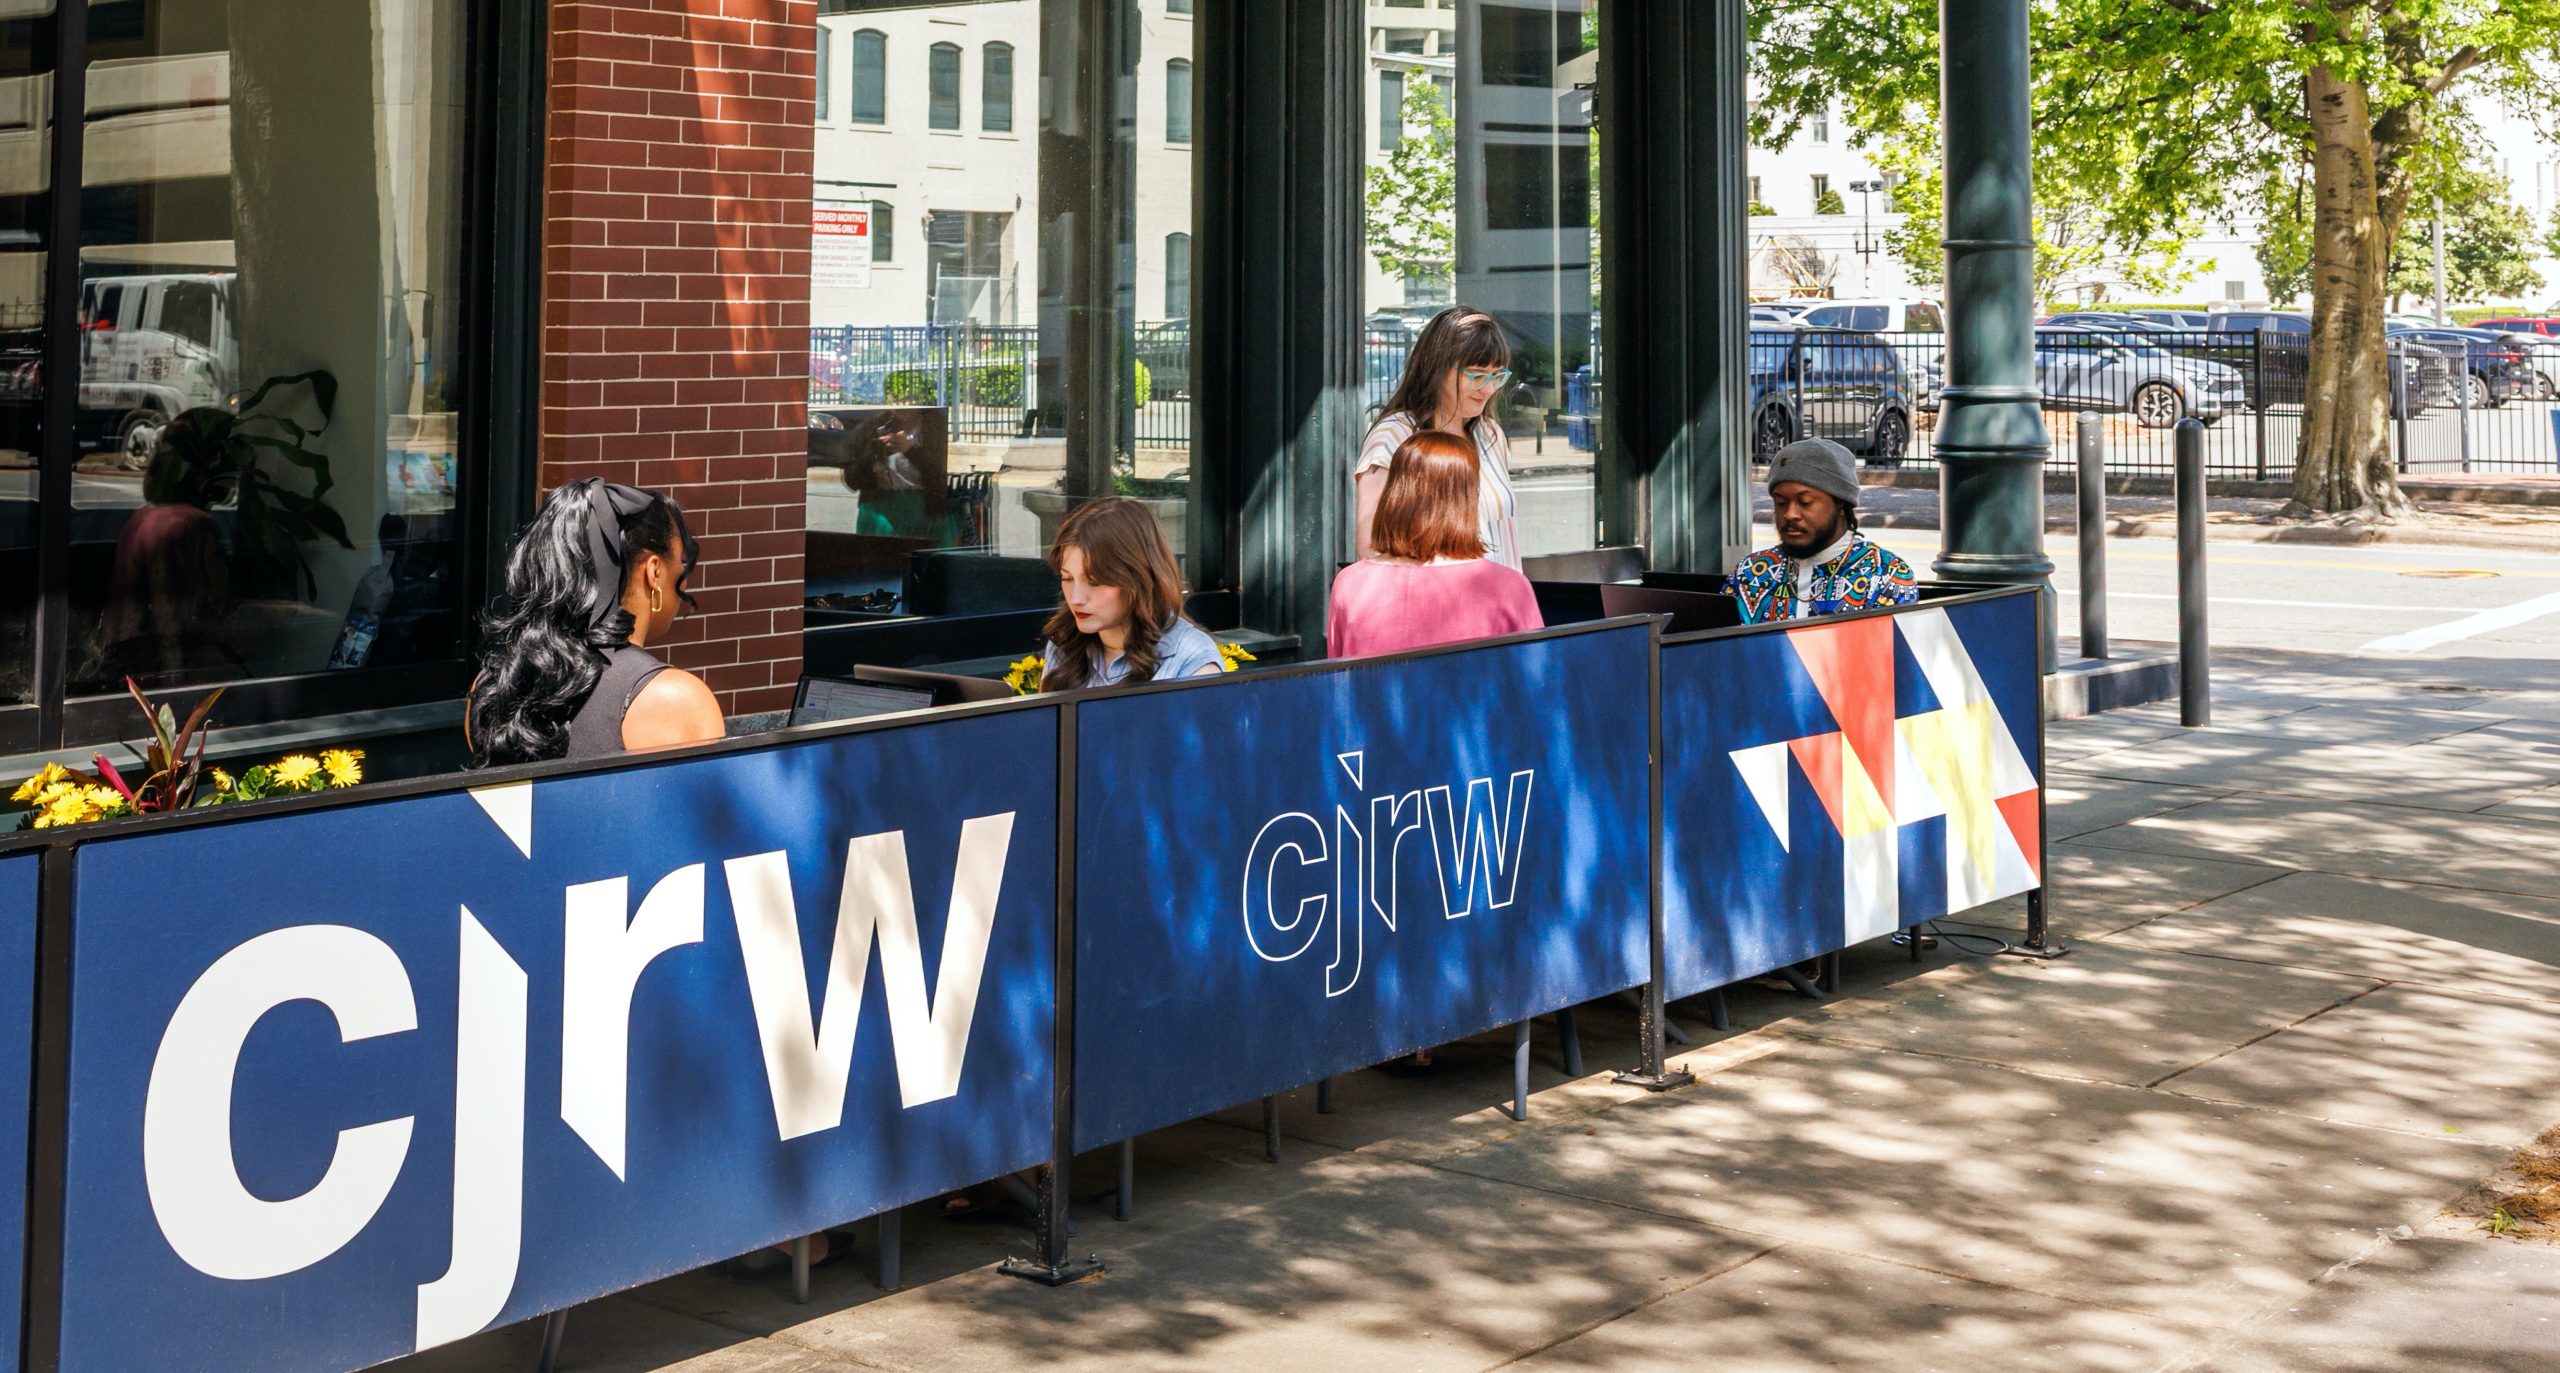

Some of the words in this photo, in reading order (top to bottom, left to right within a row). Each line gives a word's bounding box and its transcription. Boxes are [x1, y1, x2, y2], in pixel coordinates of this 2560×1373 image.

[813, 212, 837, 221] SERVED
[838, 213, 867, 223] MONTHLY
[814, 223, 841, 233] PARKING
[842, 225, 858, 234] ONLY
[1243, 751, 1534, 997] cjrw
[143, 780, 1016, 1353] cjrw
